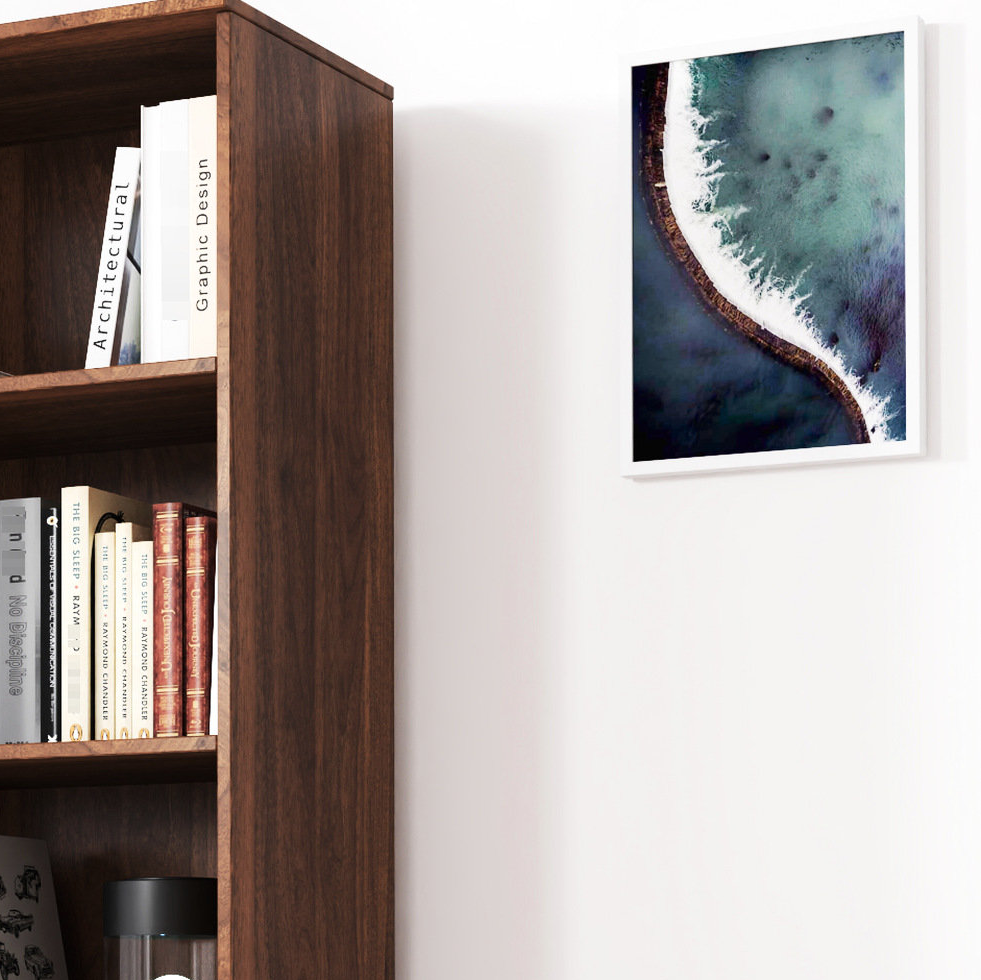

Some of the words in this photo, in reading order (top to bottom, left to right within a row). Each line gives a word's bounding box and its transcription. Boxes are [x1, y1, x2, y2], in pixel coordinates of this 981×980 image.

[196, 158, 211, 226] Design
[93, 182, 130, 350] Architectural
[196, 234, 211, 312] Graphic
[8, 594, 28, 618] No
[4, 621, 28, 697] Discipline
